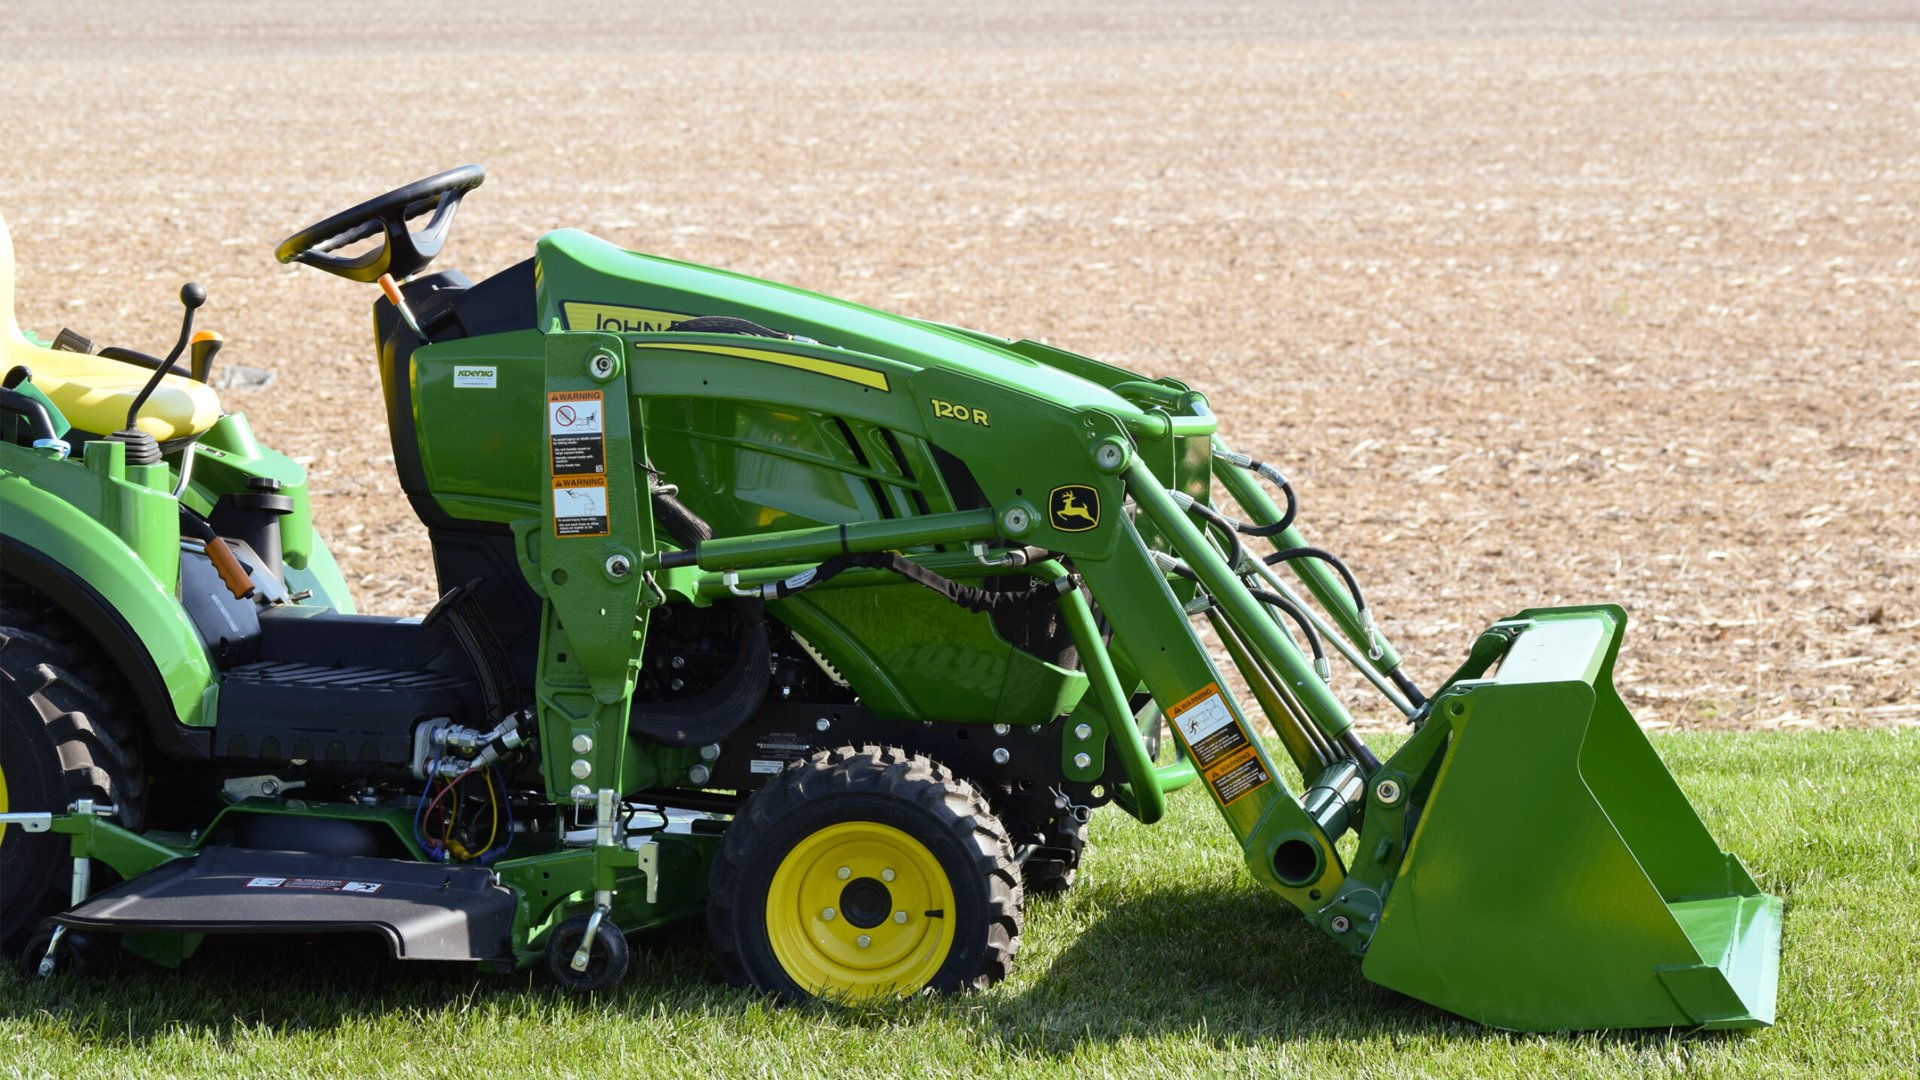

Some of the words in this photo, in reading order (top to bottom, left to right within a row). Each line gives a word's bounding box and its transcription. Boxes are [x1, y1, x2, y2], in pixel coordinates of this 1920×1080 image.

[559, 392, 600, 400] WARNING
[930, 398, 970, 421] 120
[971, 407, 990, 427] R
[563, 478, 604, 486] WARNING
[1182, 688, 1213, 710] WARNING
[1220, 751, 1251, 773] WARNING
